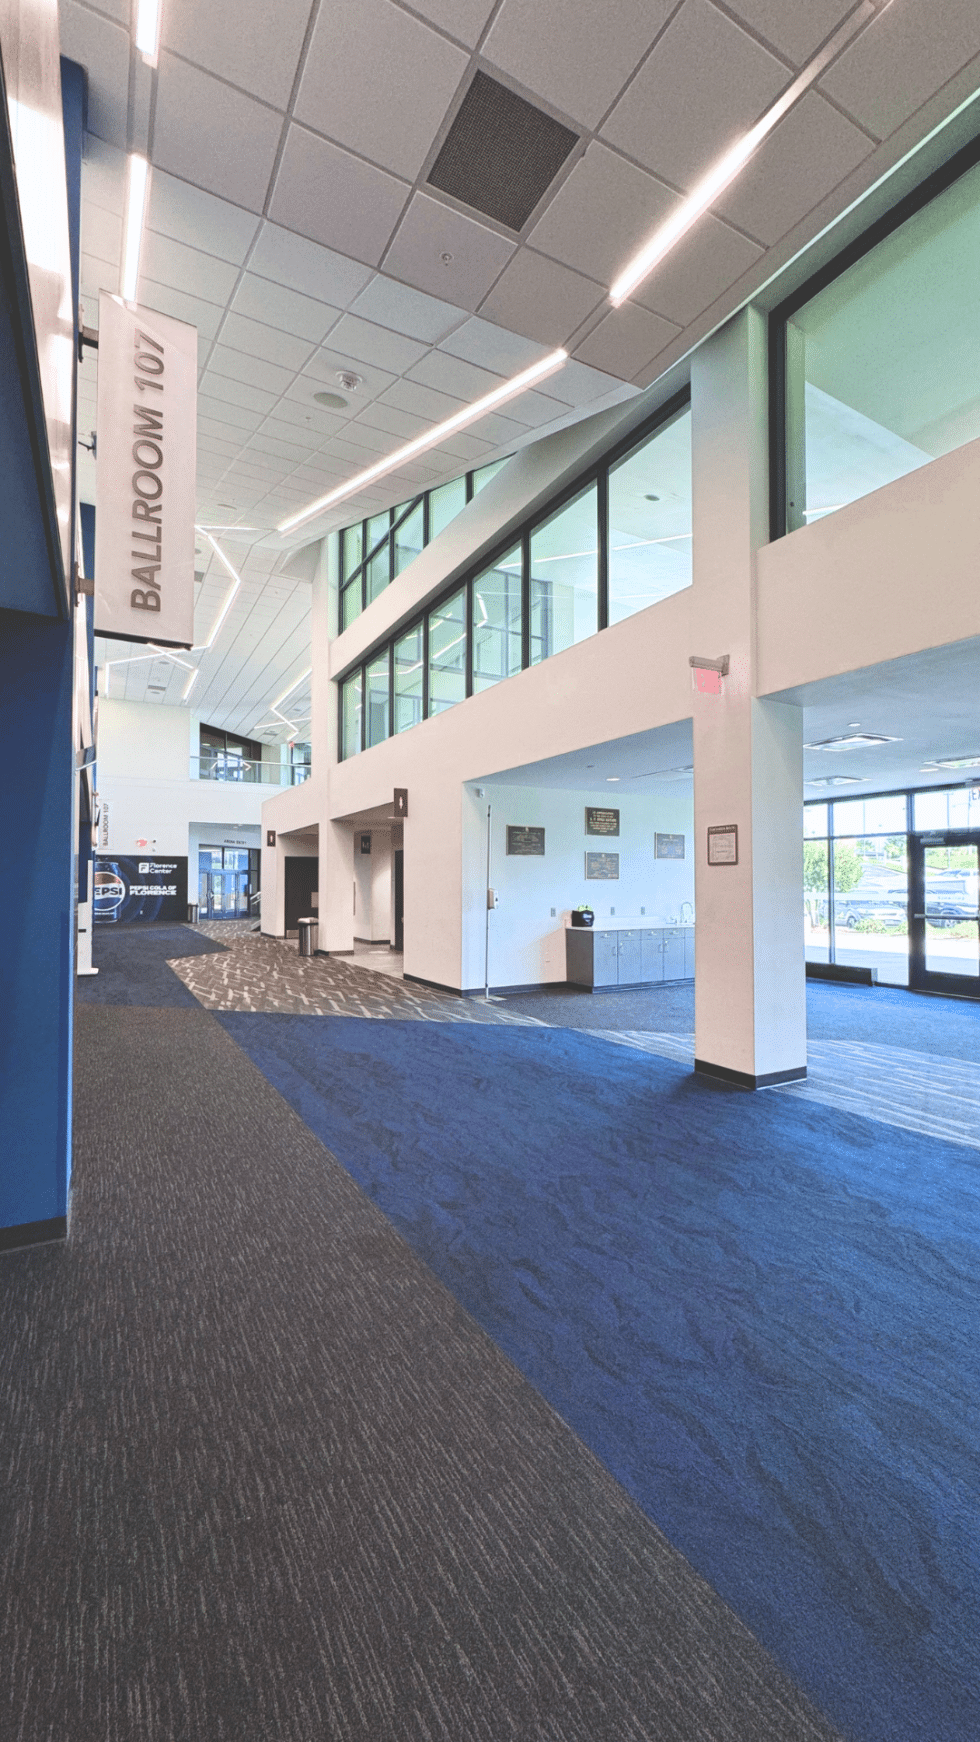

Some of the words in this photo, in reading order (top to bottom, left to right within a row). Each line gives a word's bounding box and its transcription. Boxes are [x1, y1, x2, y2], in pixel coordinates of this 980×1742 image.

[133, 328, 165, 391] 107
[130, 404, 164, 612] BALLROOM
[95, 887, 122, 895] EPSI
